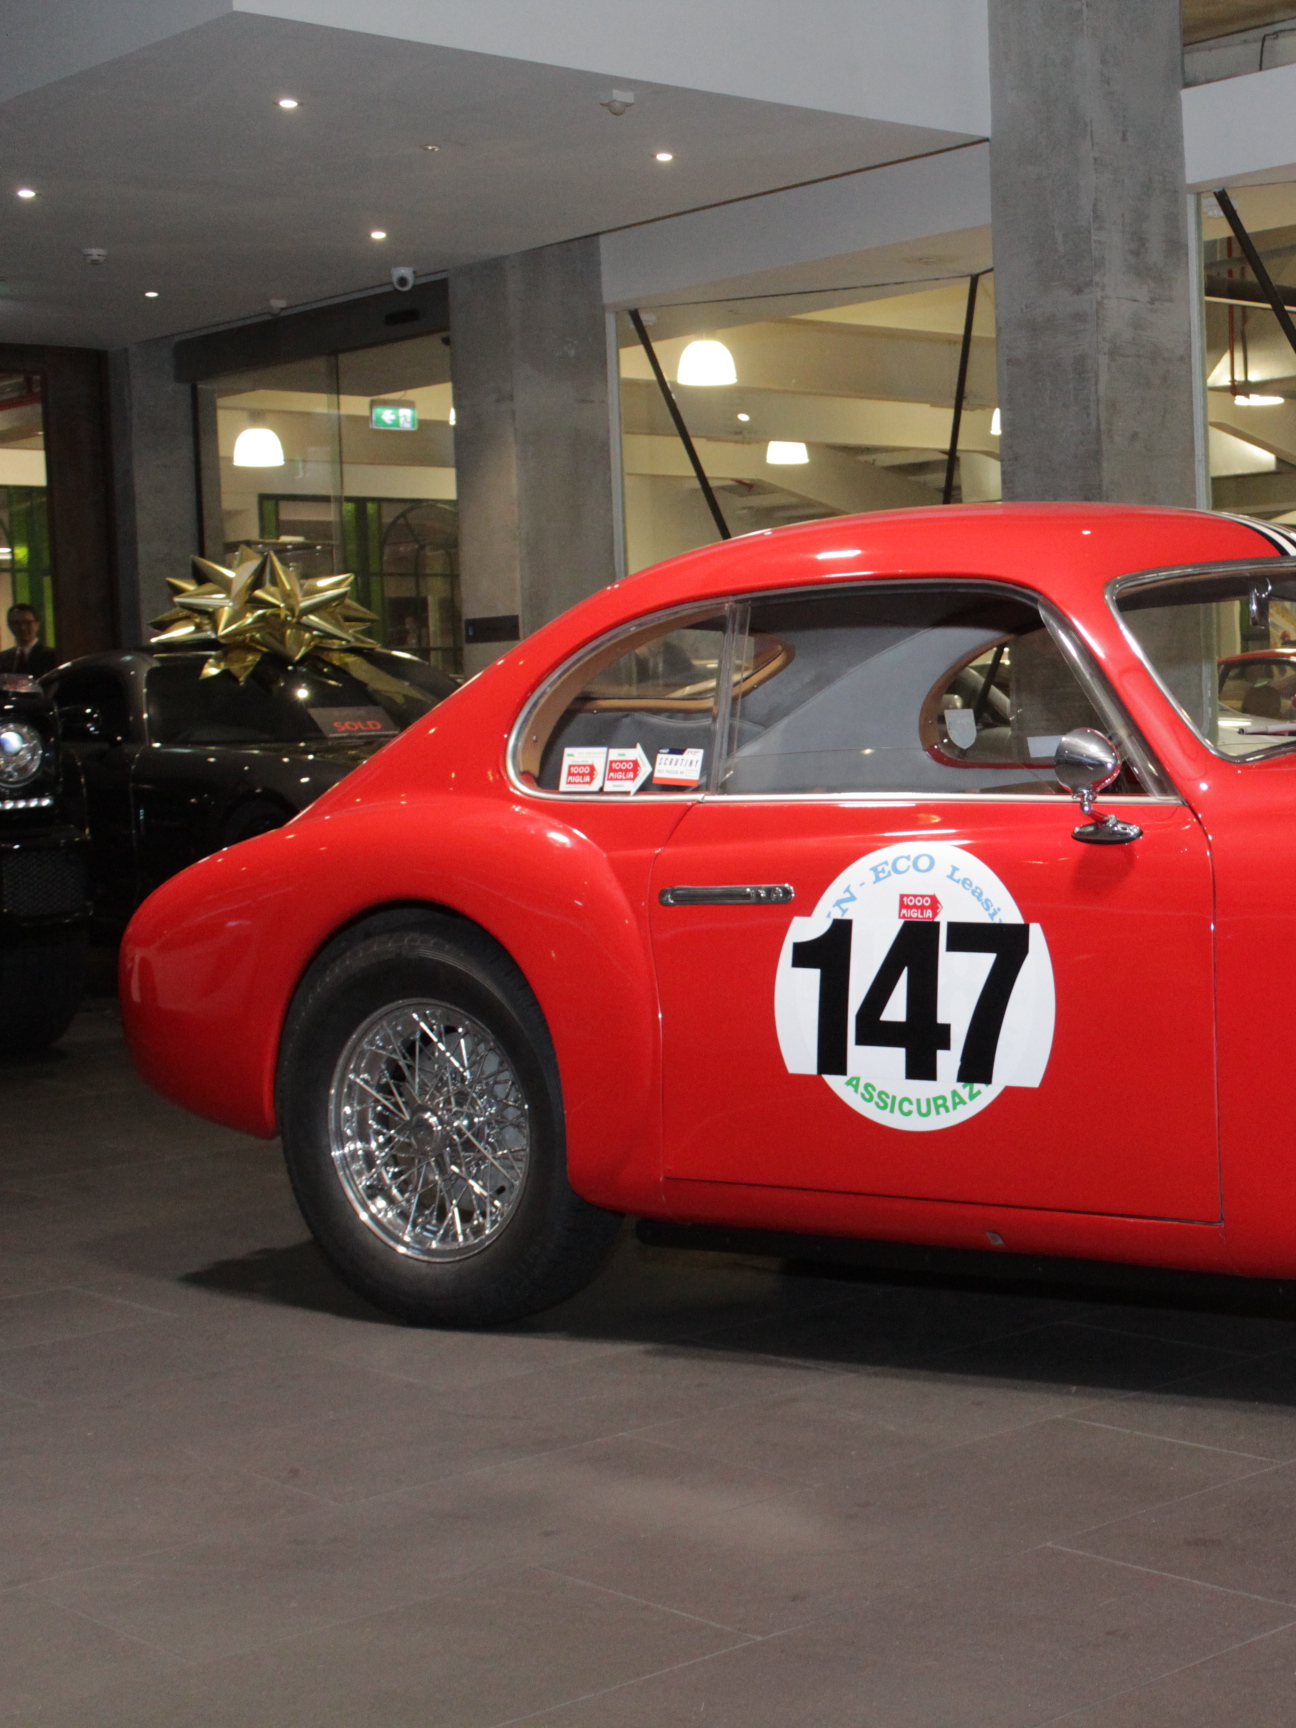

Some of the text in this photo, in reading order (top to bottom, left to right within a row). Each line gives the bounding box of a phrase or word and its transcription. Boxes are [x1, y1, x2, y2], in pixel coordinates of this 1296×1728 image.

[333, 720, 382, 731] SOLD
[612, 761, 634, 770] 1000
[658, 757, 700, 768] SCRUTINY
[570, 766, 590, 774] 1000
[567, 775, 590, 783] MIGLIA
[608, 771, 634, 780] MIGLIA
[826, 884, 857, 918] N
[946, 864, 1003, 924] Leasi
[903, 896, 931, 906] 1000
[900, 908, 933, 918] MIGLIA
[791, 918, 1030, 1085] 147
[844, 1076, 992, 1118] ASSICURAZ
